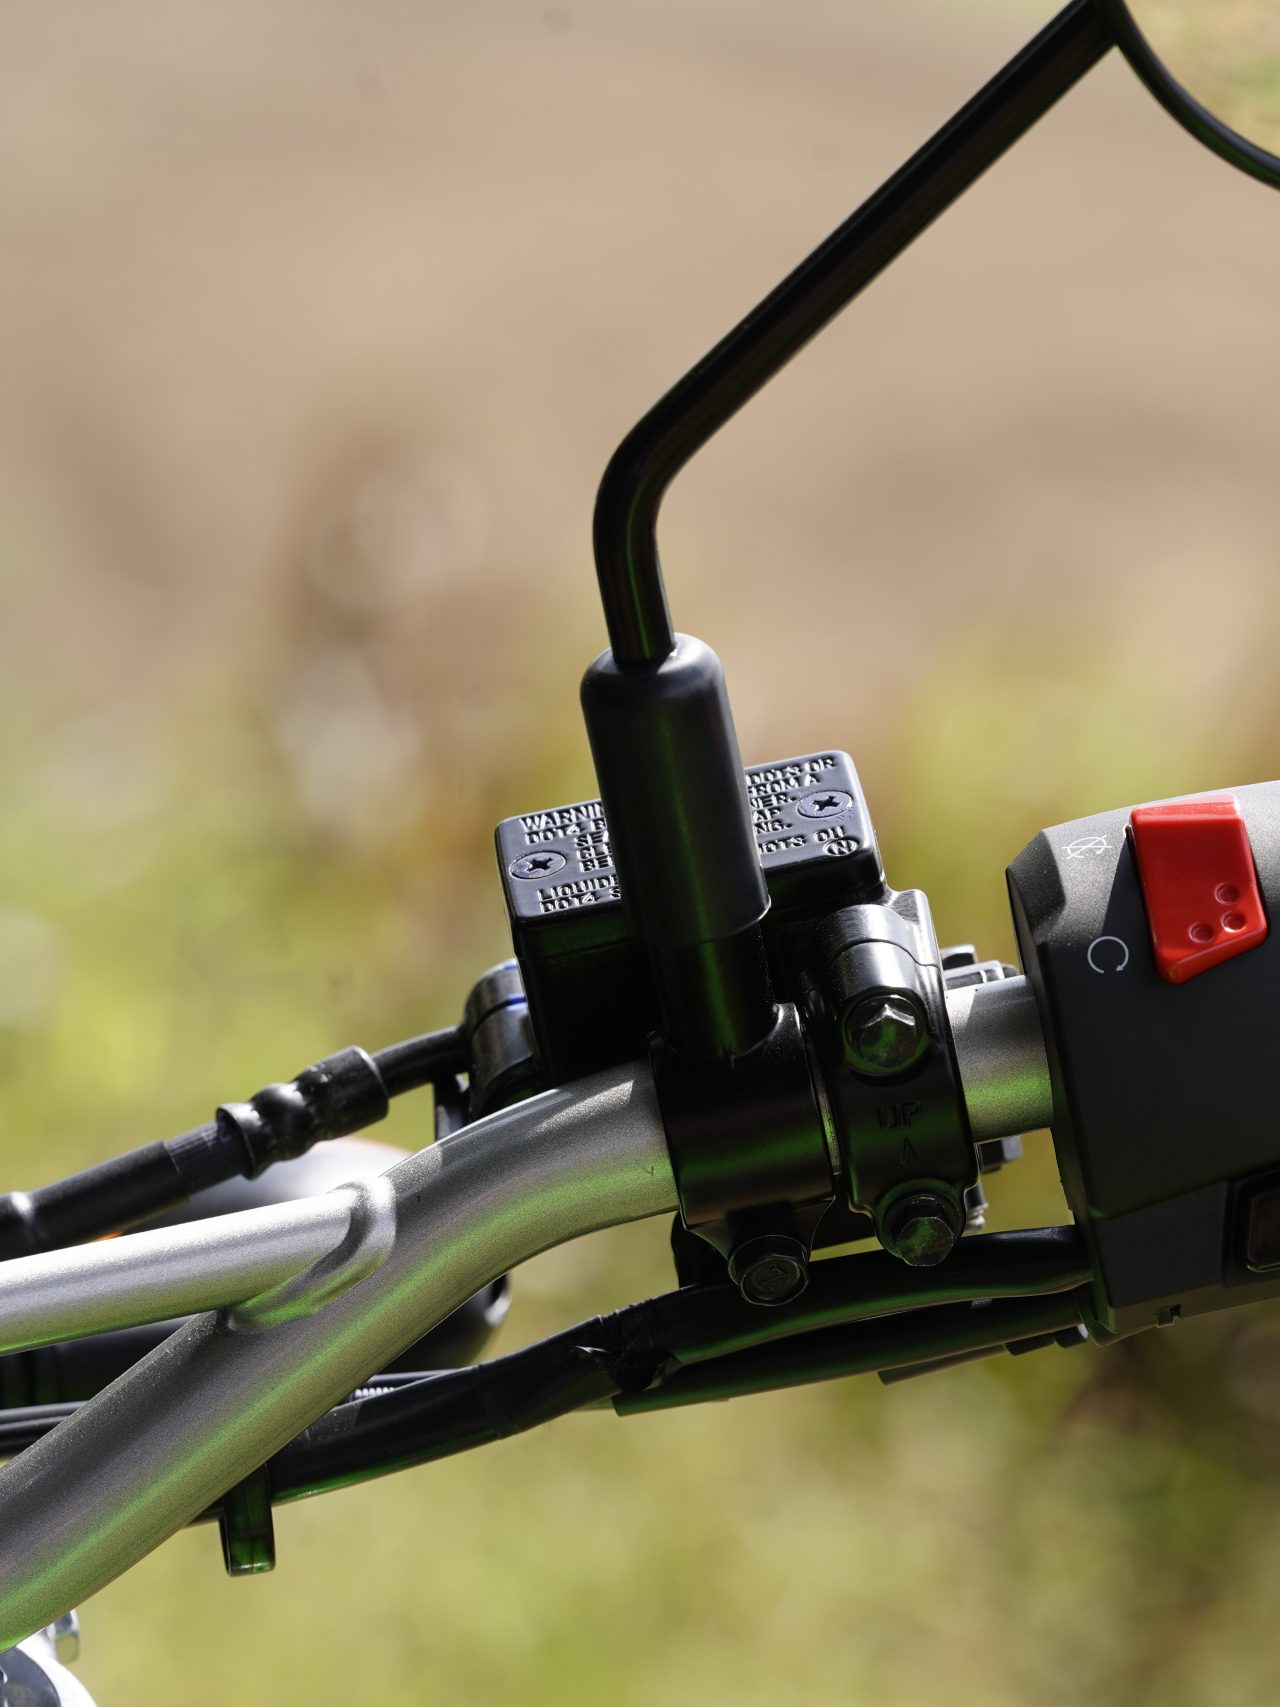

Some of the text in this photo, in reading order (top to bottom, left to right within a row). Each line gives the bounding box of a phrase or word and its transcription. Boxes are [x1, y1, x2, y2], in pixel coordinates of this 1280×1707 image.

[804, 756, 835, 773] OR
[525, 824, 585, 845] DOT4
[804, 773, 821, 787] A
[540, 893, 600, 913] DOT4
[877, 1100, 924, 1131] UP
